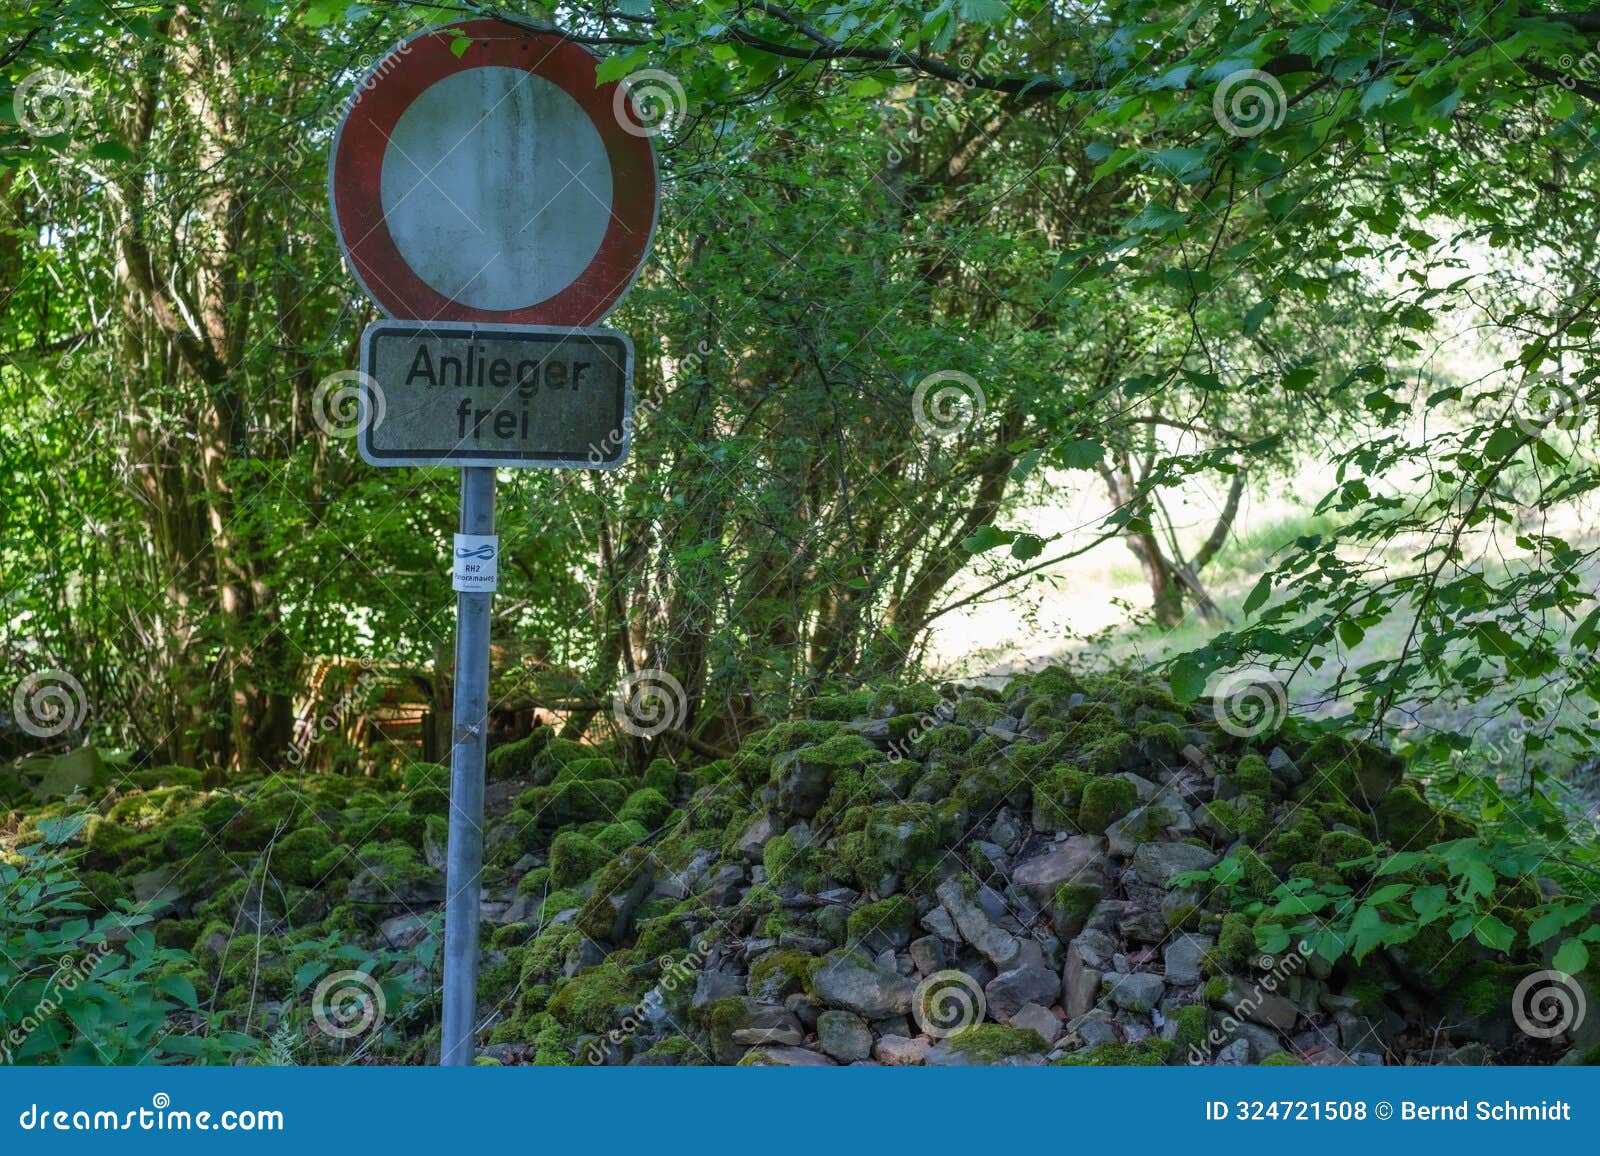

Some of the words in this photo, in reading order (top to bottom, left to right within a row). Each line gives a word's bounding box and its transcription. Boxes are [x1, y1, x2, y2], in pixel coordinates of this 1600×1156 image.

[405, 343, 592, 398] Anlieger
[456, 398, 529, 440] frei
[465, 564, 481, 573] RH2
